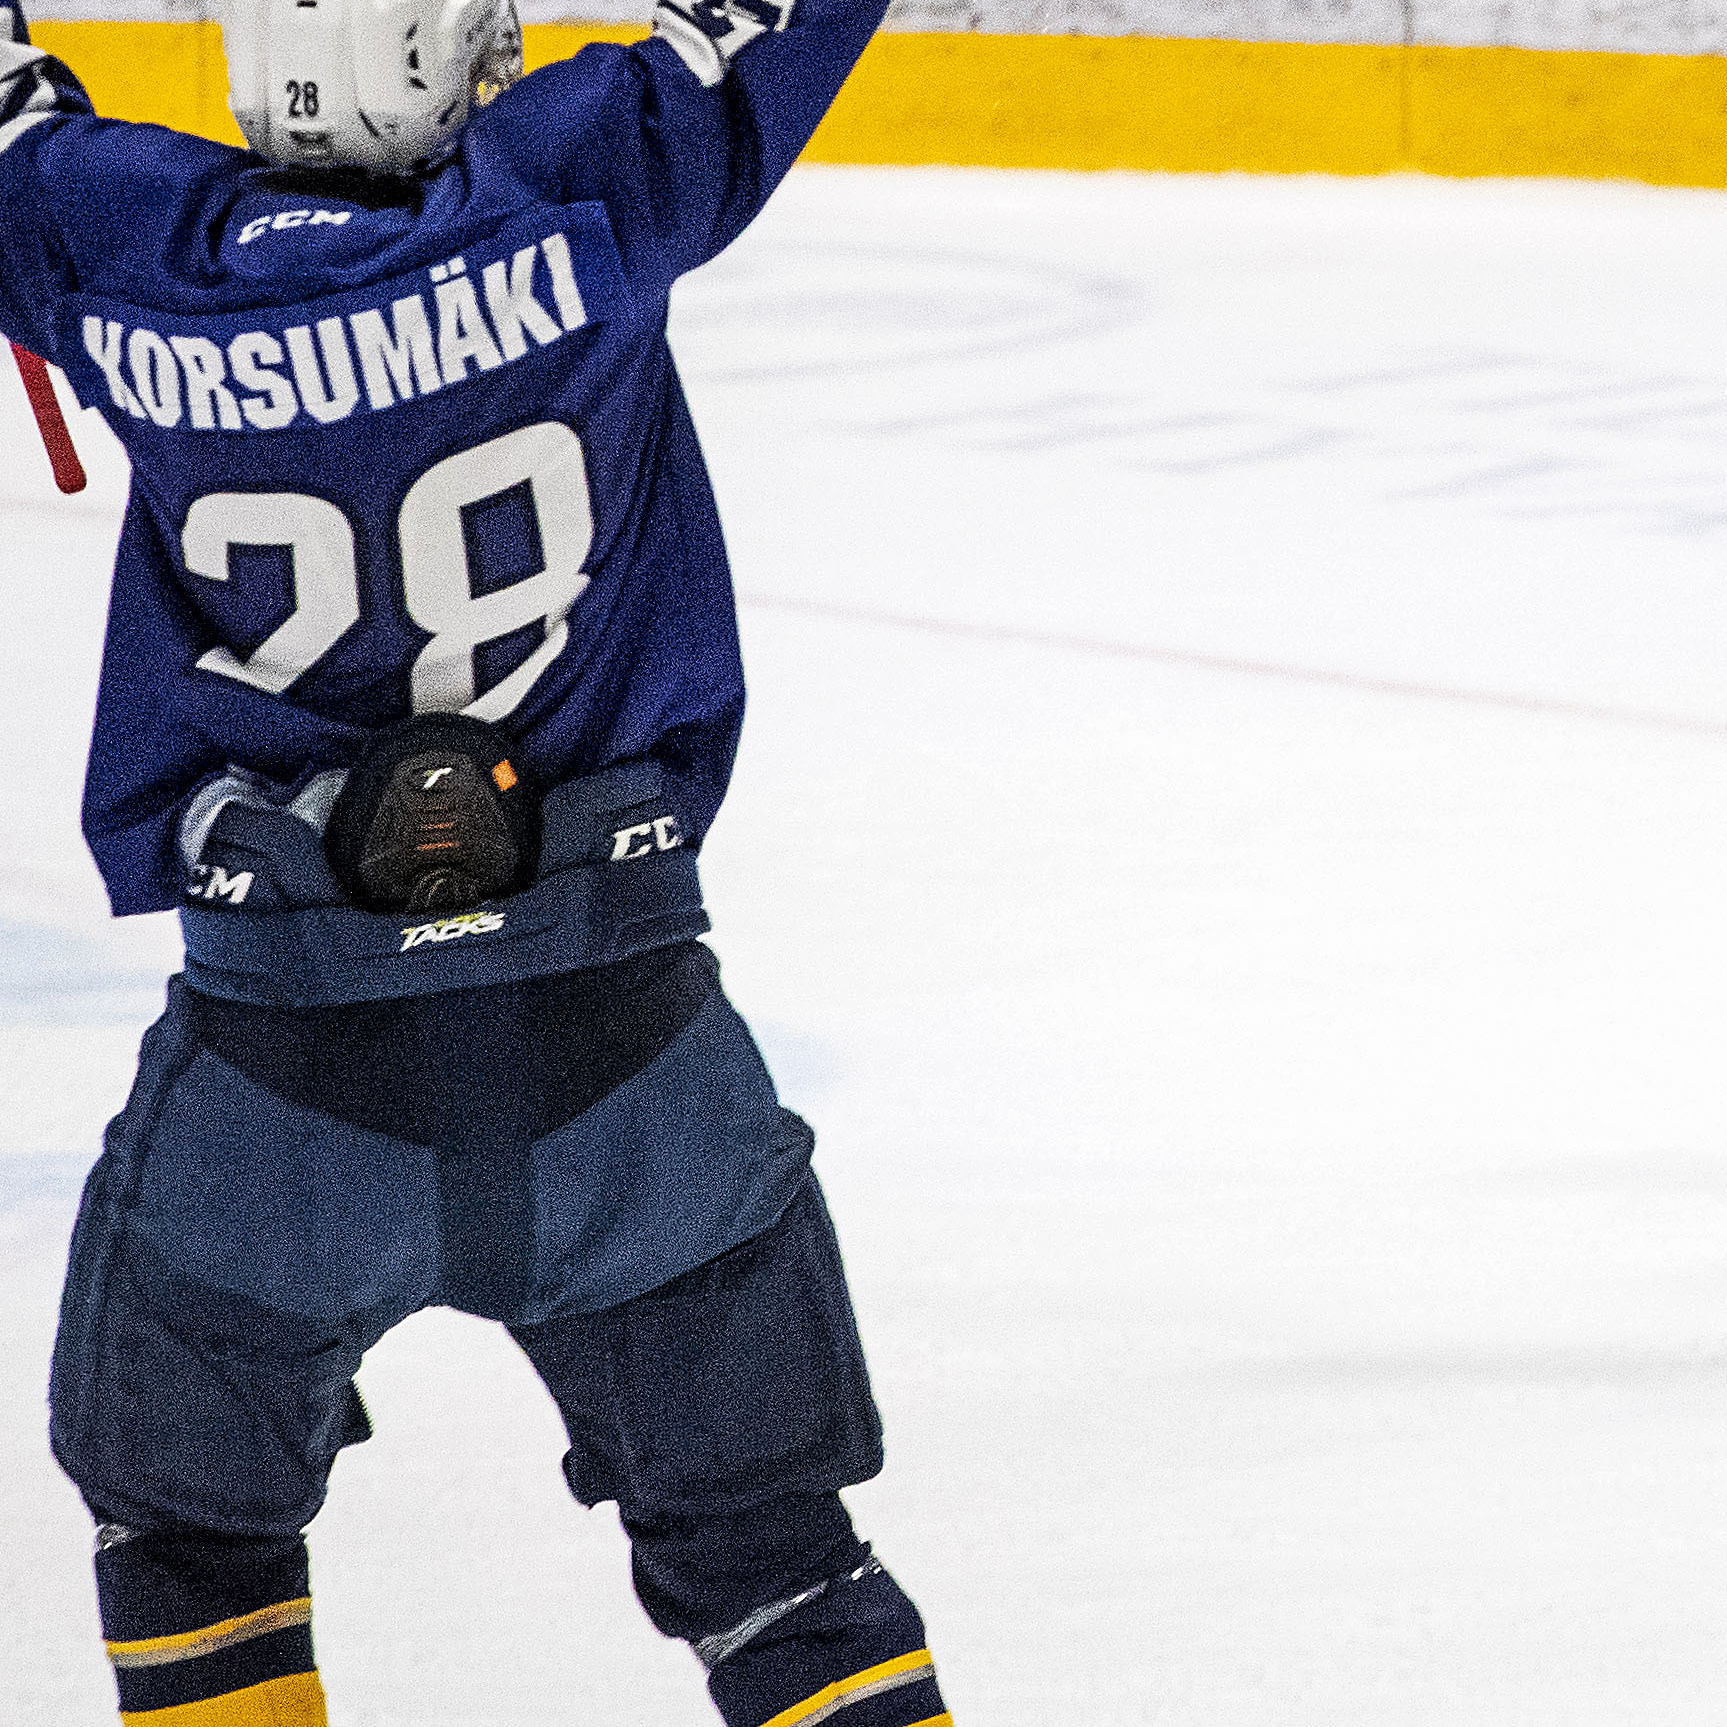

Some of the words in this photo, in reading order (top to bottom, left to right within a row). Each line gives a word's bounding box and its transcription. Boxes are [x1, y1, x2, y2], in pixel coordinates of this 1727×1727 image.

[286, 79, 322, 119] 28
[236, 208, 352, 245] CCM
[81, 233, 588, 432] KORSUMÄKI
[180, 420, 596, 723] 28
